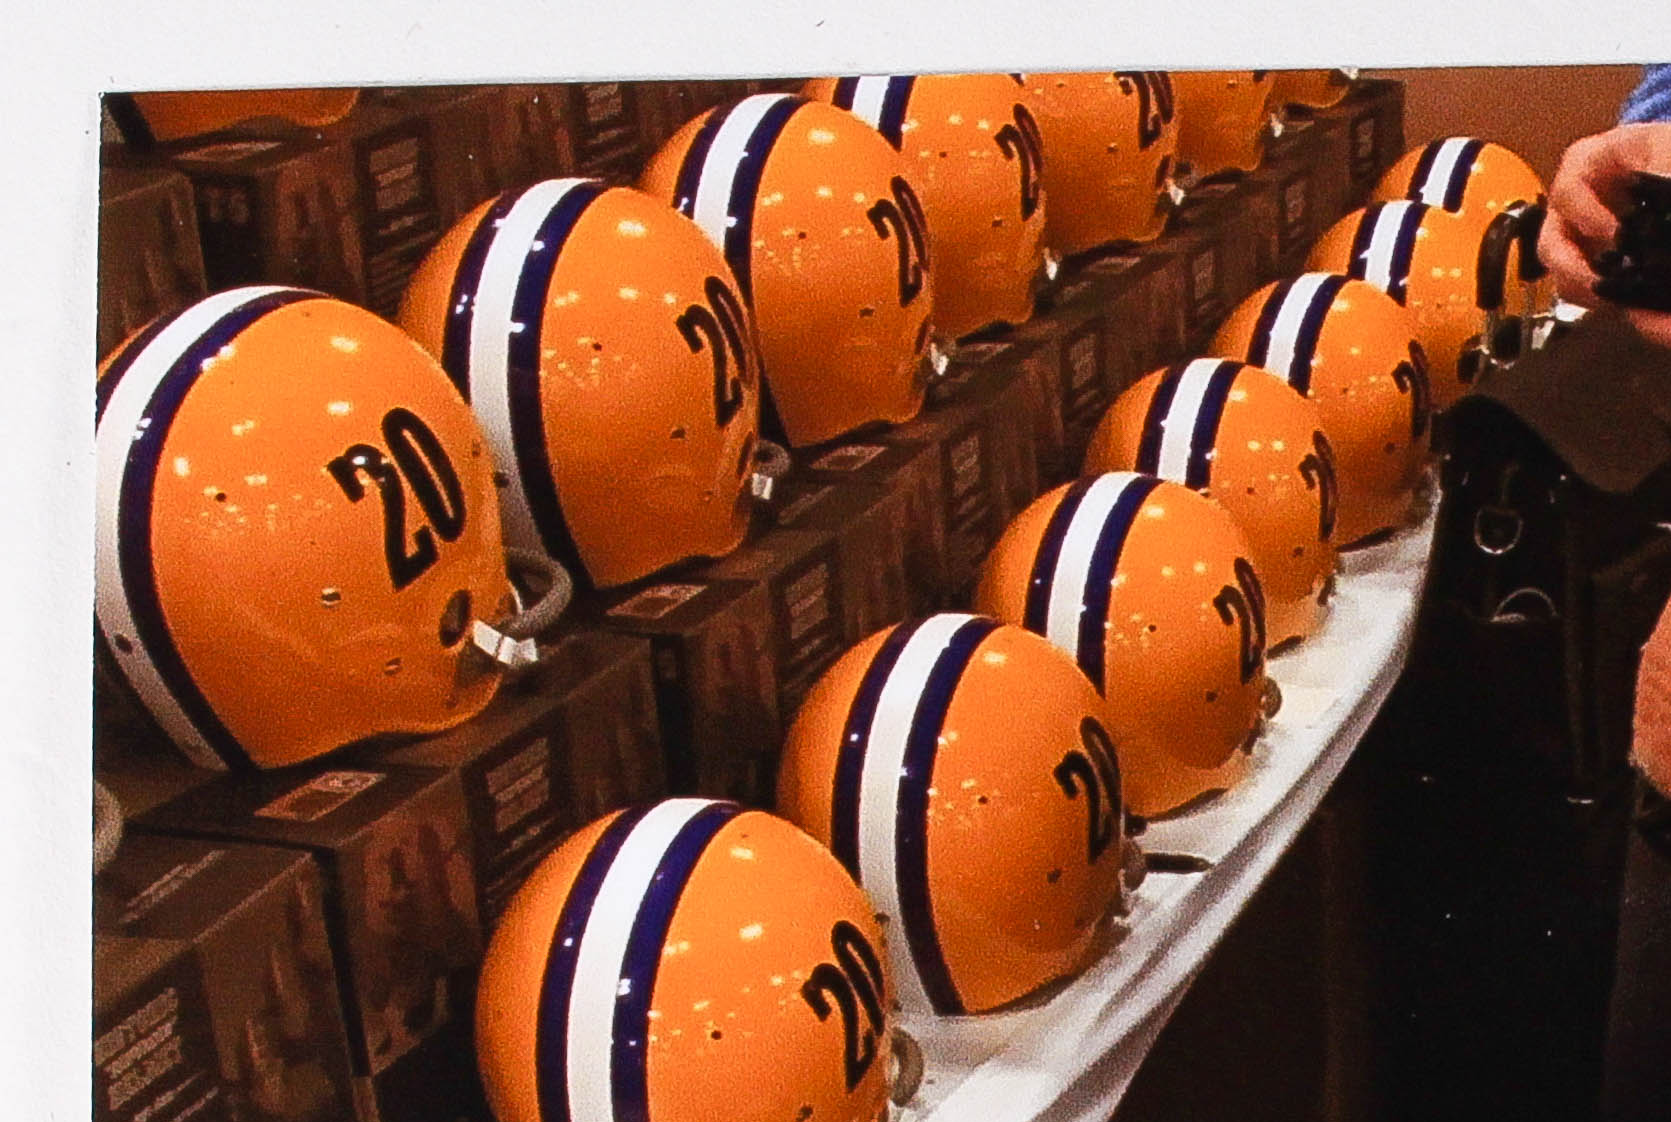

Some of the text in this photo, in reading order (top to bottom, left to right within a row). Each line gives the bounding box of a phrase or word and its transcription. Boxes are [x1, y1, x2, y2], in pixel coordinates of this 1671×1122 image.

[867, 176, 928, 308] 20
[676, 276, 752, 427] 20
[327, 407, 466, 590] 20
[1213, 557, 1265, 685] 20
[1054, 716, 1122, 866] 20
[801, 921, 884, 1092] 20
